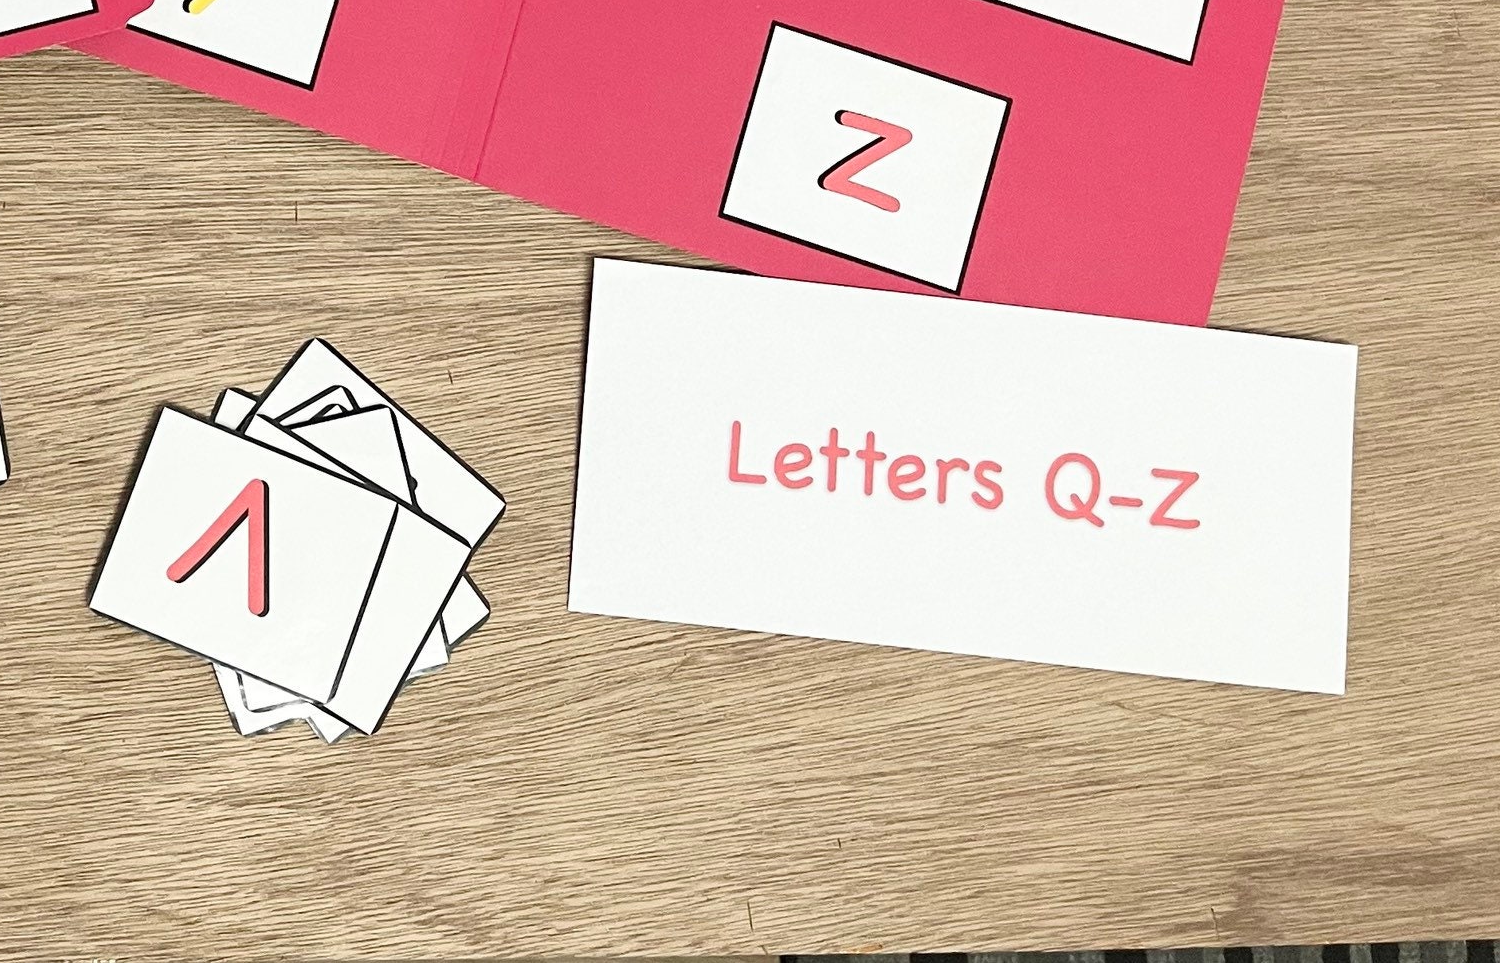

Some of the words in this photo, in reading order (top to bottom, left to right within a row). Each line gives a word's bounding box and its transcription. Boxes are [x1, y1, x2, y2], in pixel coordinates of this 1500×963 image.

[817, 110, 913, 213] z
[728, 421, 1003, 510] Letters
[1045, 453, 1200, 529] Q-Z
